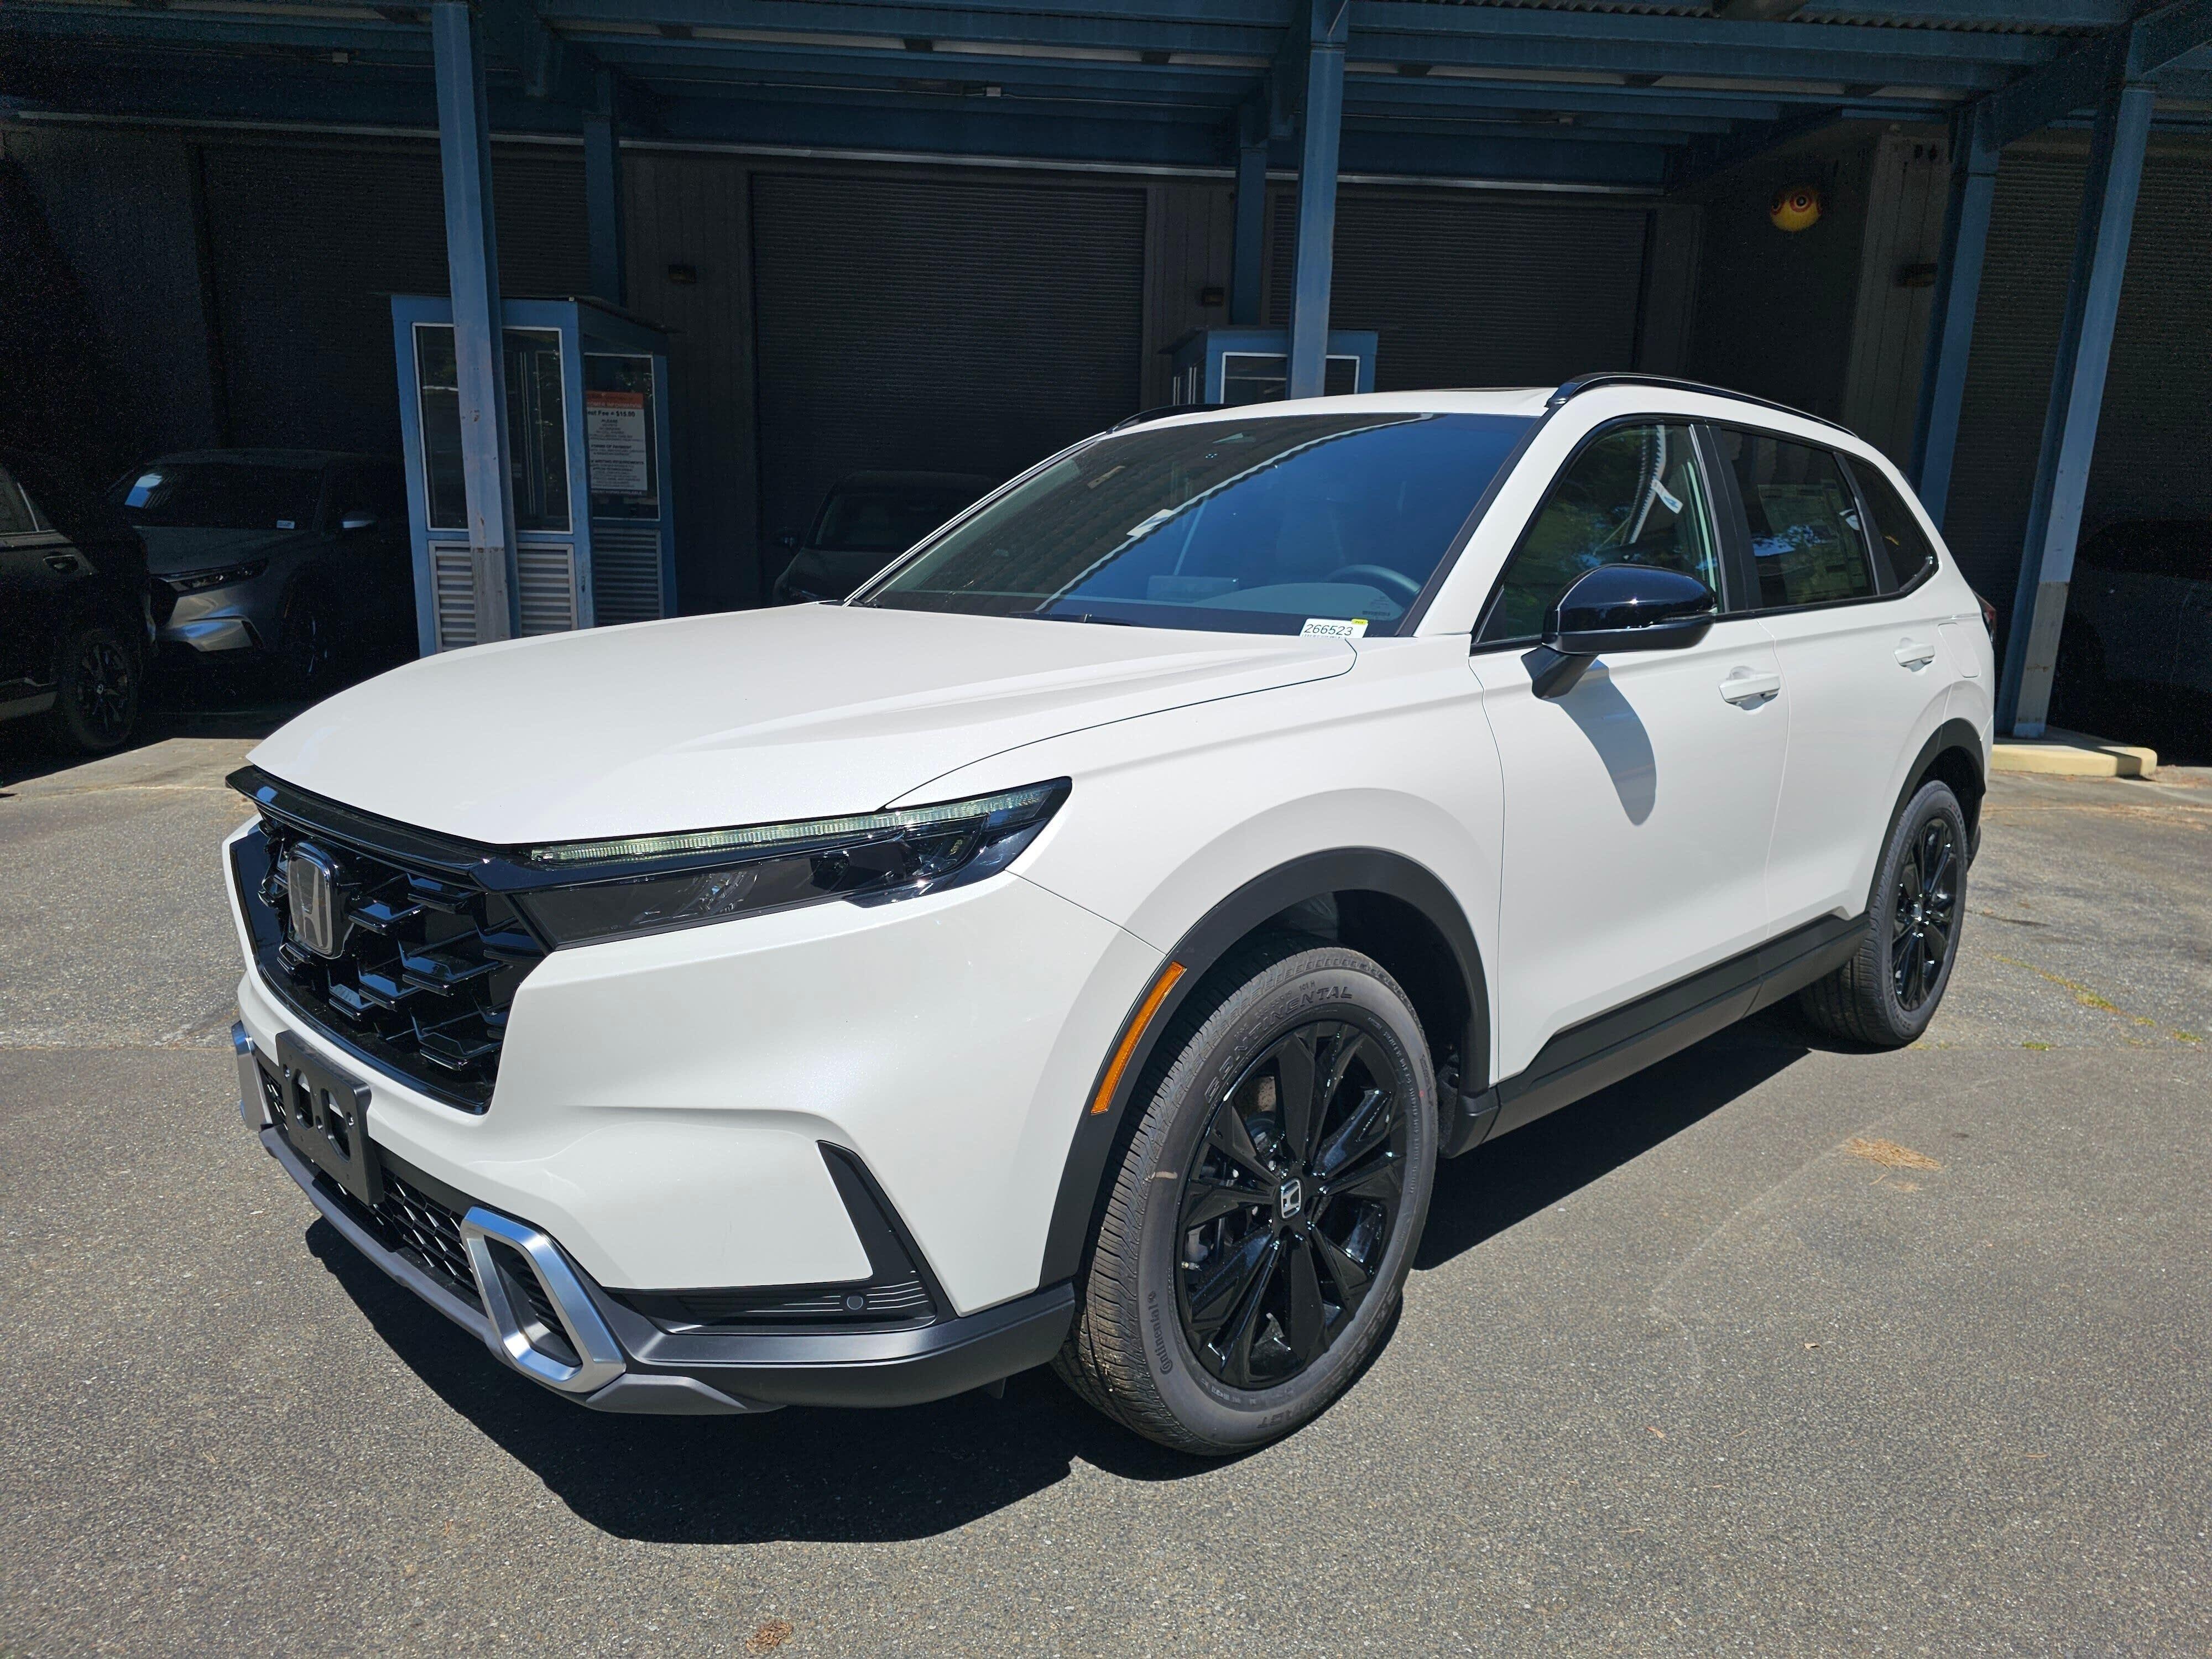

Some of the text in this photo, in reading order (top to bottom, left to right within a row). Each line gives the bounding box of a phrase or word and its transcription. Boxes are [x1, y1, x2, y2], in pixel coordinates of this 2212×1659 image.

[1304, 624, 1353, 636] 266523
[1204, 986, 1353, 1103] CONTINENTAL
[1148, 1303, 1173, 1375] Continental
